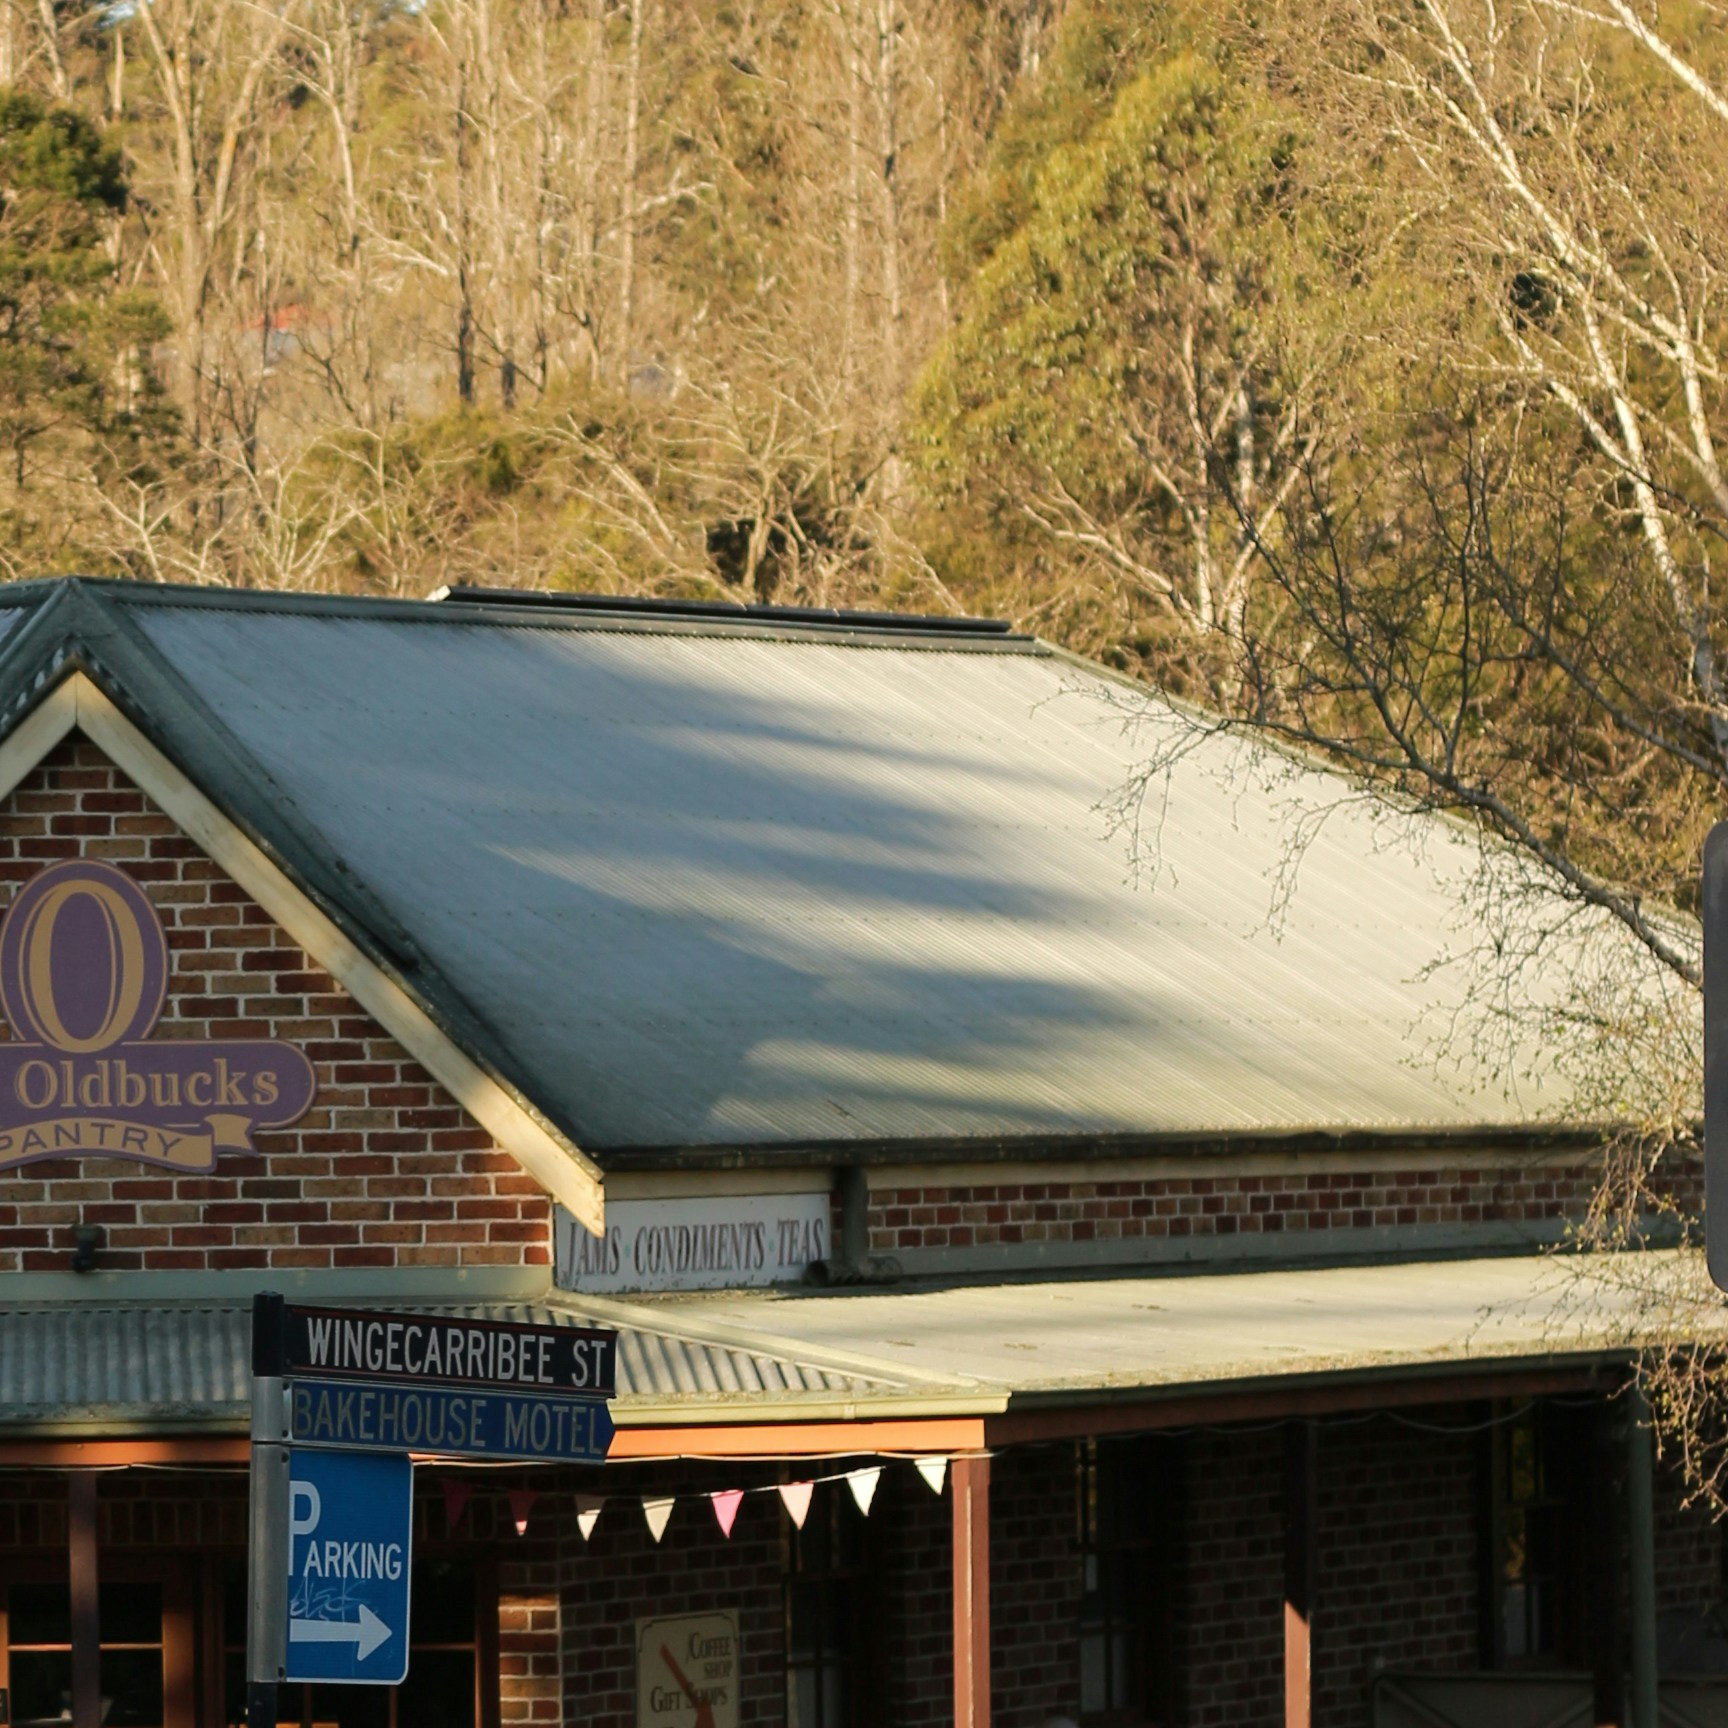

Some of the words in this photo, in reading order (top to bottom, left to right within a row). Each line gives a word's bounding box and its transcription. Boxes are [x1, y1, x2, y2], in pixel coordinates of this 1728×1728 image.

[13, 1058, 280, 1109] Oldbucks
[633, 1221, 766, 1273] CONDIMENTS
[776, 1218, 823, 1267] TEAS
[306, 1317, 557, 1384] WINGECARRIBEE
[571, 1338, 607, 1388] ST
[292, 1387, 488, 1448] BAKEHOUSE
[503, 1402, 604, 1456] MOTEL
[650, 1685, 682, 1713] GIFT
